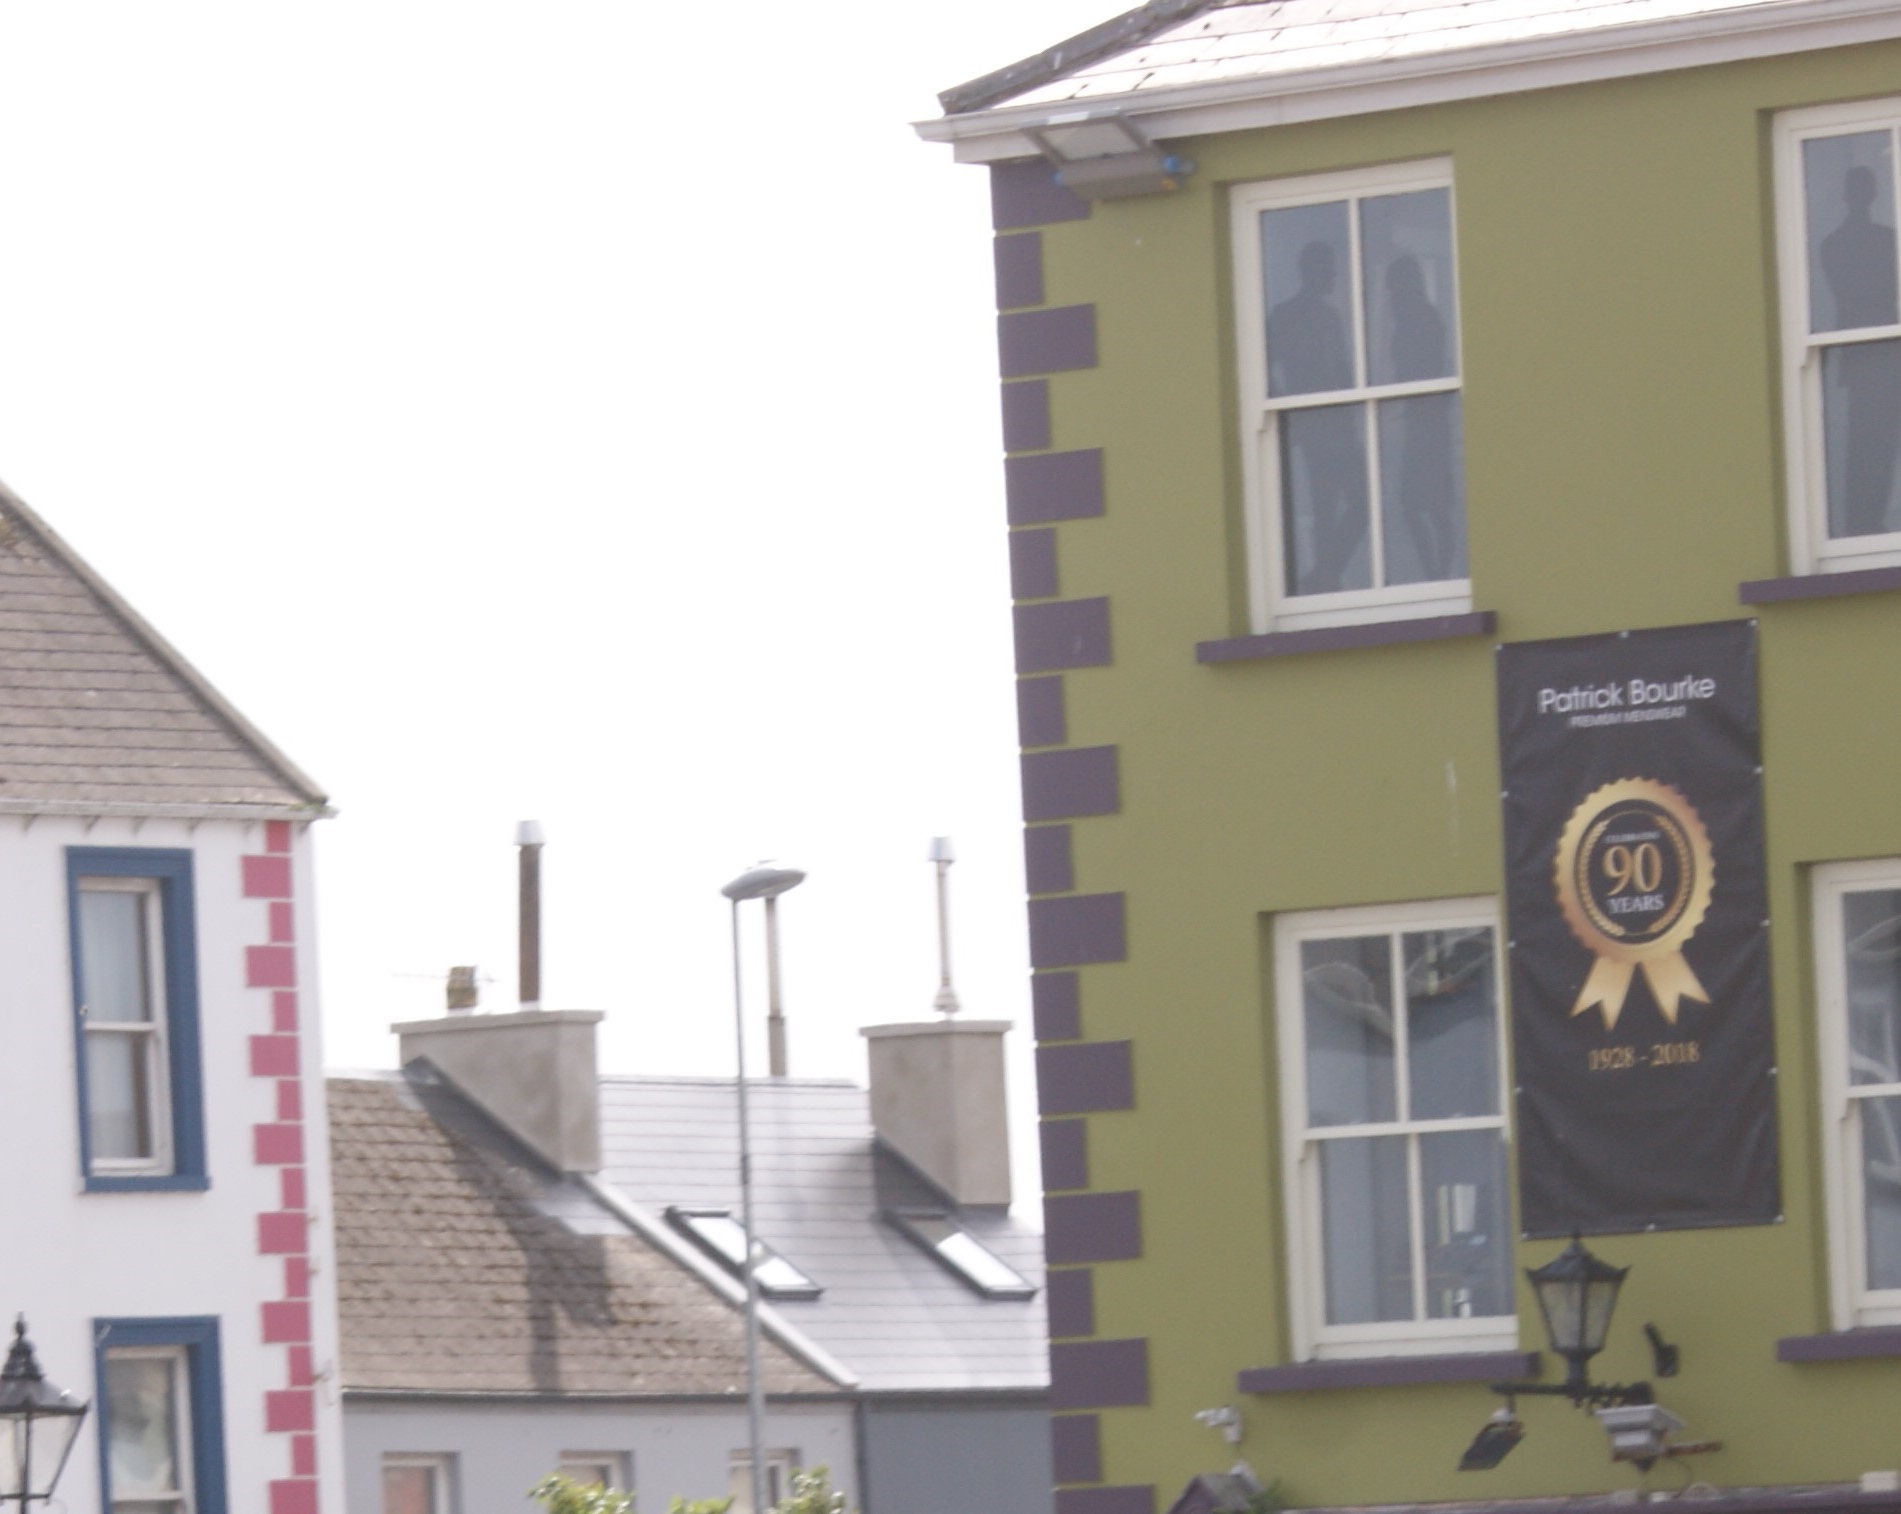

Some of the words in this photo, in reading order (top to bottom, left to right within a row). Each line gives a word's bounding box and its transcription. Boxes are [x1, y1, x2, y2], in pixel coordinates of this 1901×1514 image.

[1540, 682, 1624, 713] Patrick
[1630, 675, 1716, 704] Bourke
[1603, 843, 1663, 897] 90
[1608, 894, 1665, 915] YEARS
[1589, 1046, 1636, 1071] 1928
[1651, 1040, 1700, 1066] 2018
